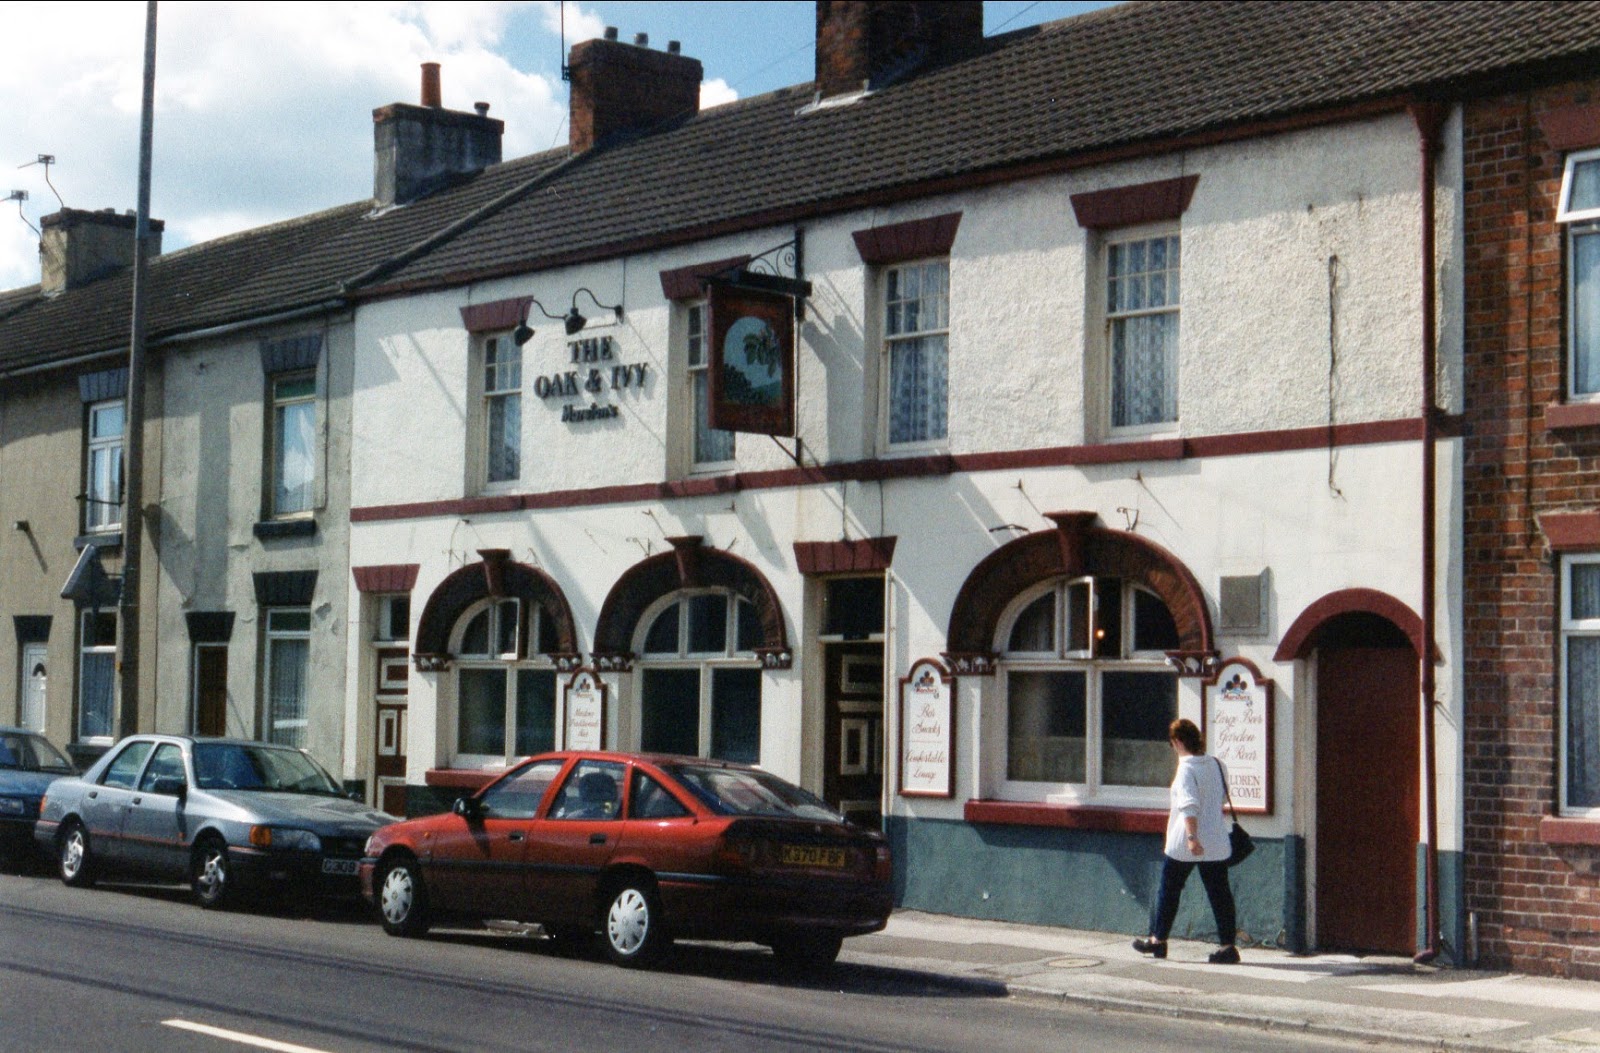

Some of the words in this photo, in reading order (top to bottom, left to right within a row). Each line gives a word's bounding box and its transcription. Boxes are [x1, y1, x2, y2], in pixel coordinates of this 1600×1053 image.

[567, 336, 613, 363] THE
[534, 371, 578, 399] OAK
[585, 369, 602, 393] &
[611, 362, 648, 390] IVY
[1216, 729, 1255, 748] Garden
[1230, 774, 1261, 786] LDREN
[1230, 787, 1262, 799] COME
